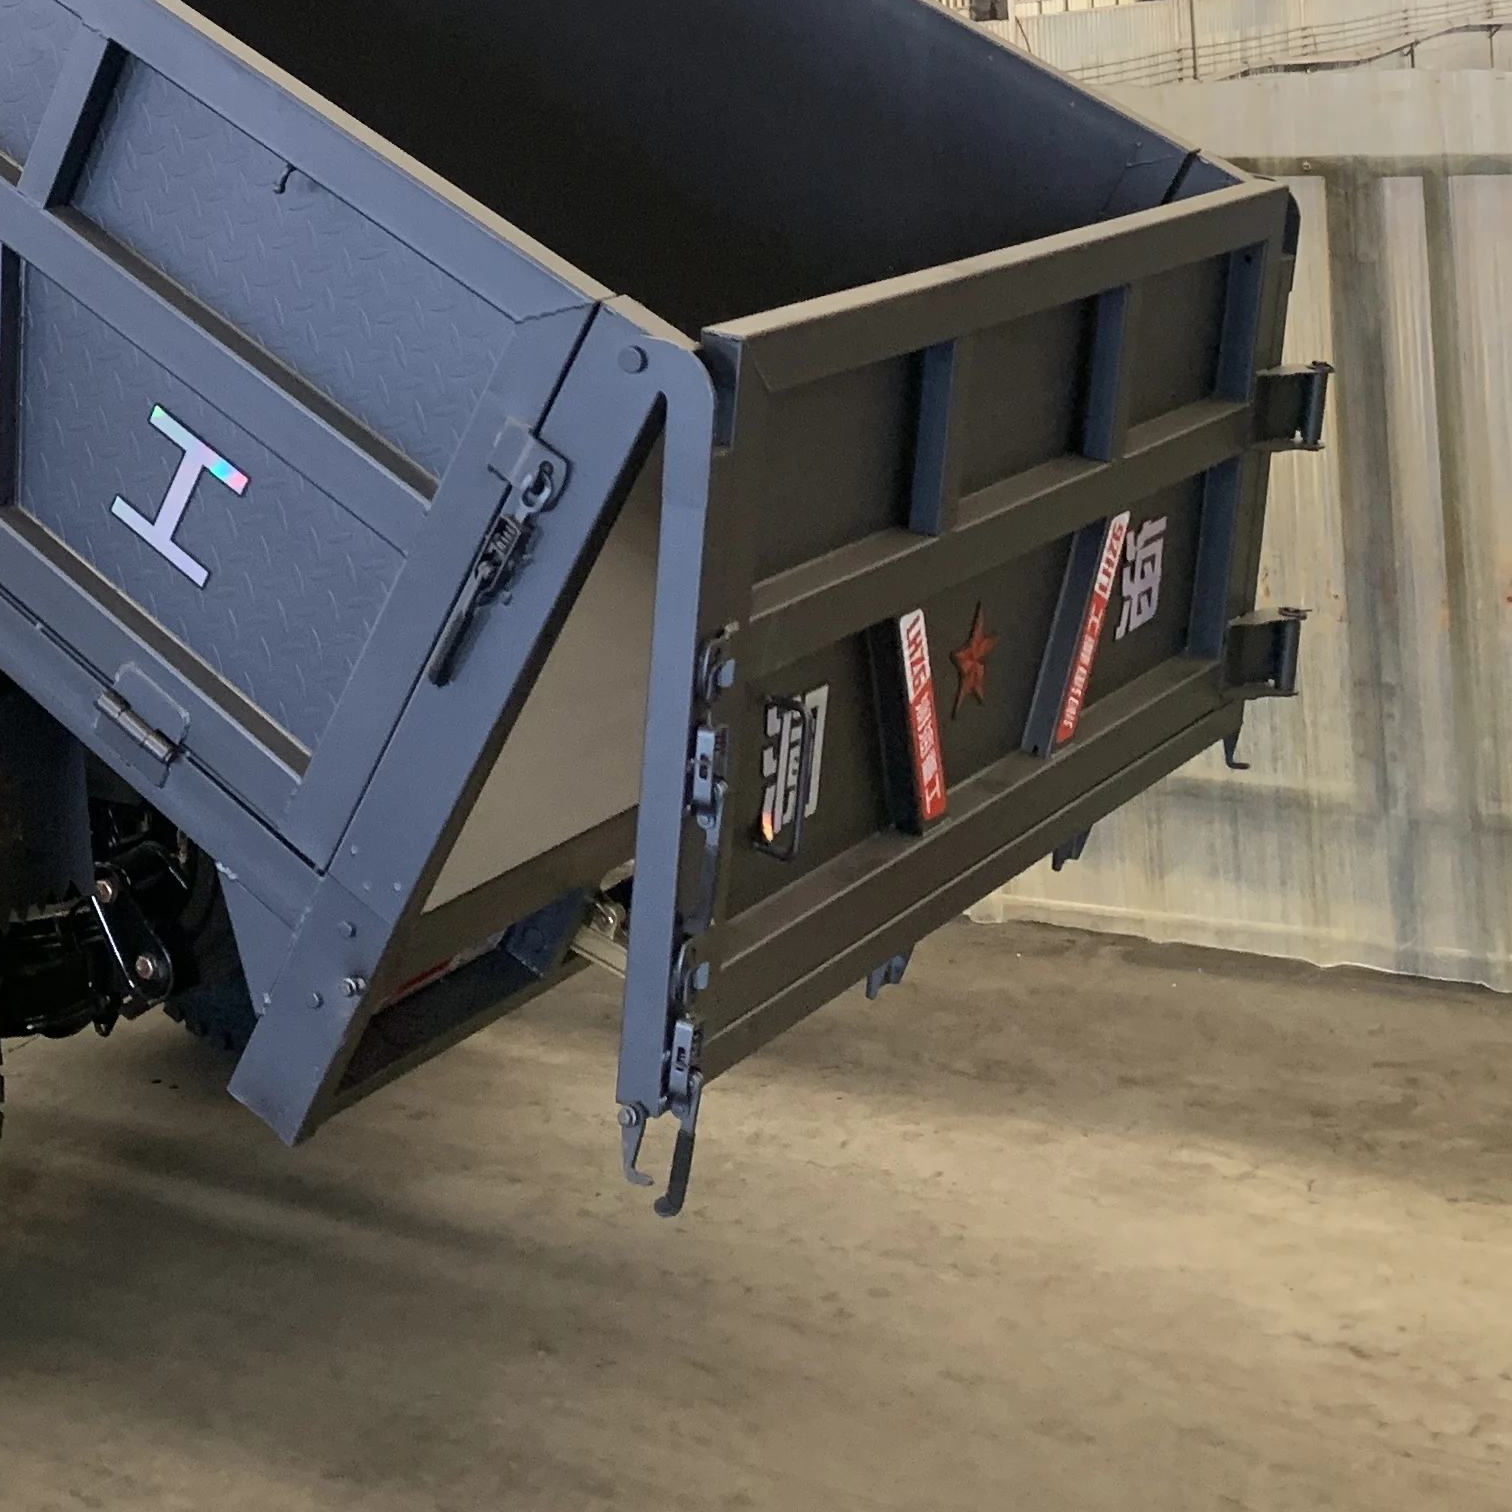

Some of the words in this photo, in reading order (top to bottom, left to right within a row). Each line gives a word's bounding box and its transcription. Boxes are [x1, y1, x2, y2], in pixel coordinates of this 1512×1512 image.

[110, 404, 249, 589] 工
[1096, 520, 1125, 597] LHZG
[1115, 516, 1169, 642] 海
[905, 615, 932, 696] LHZG
